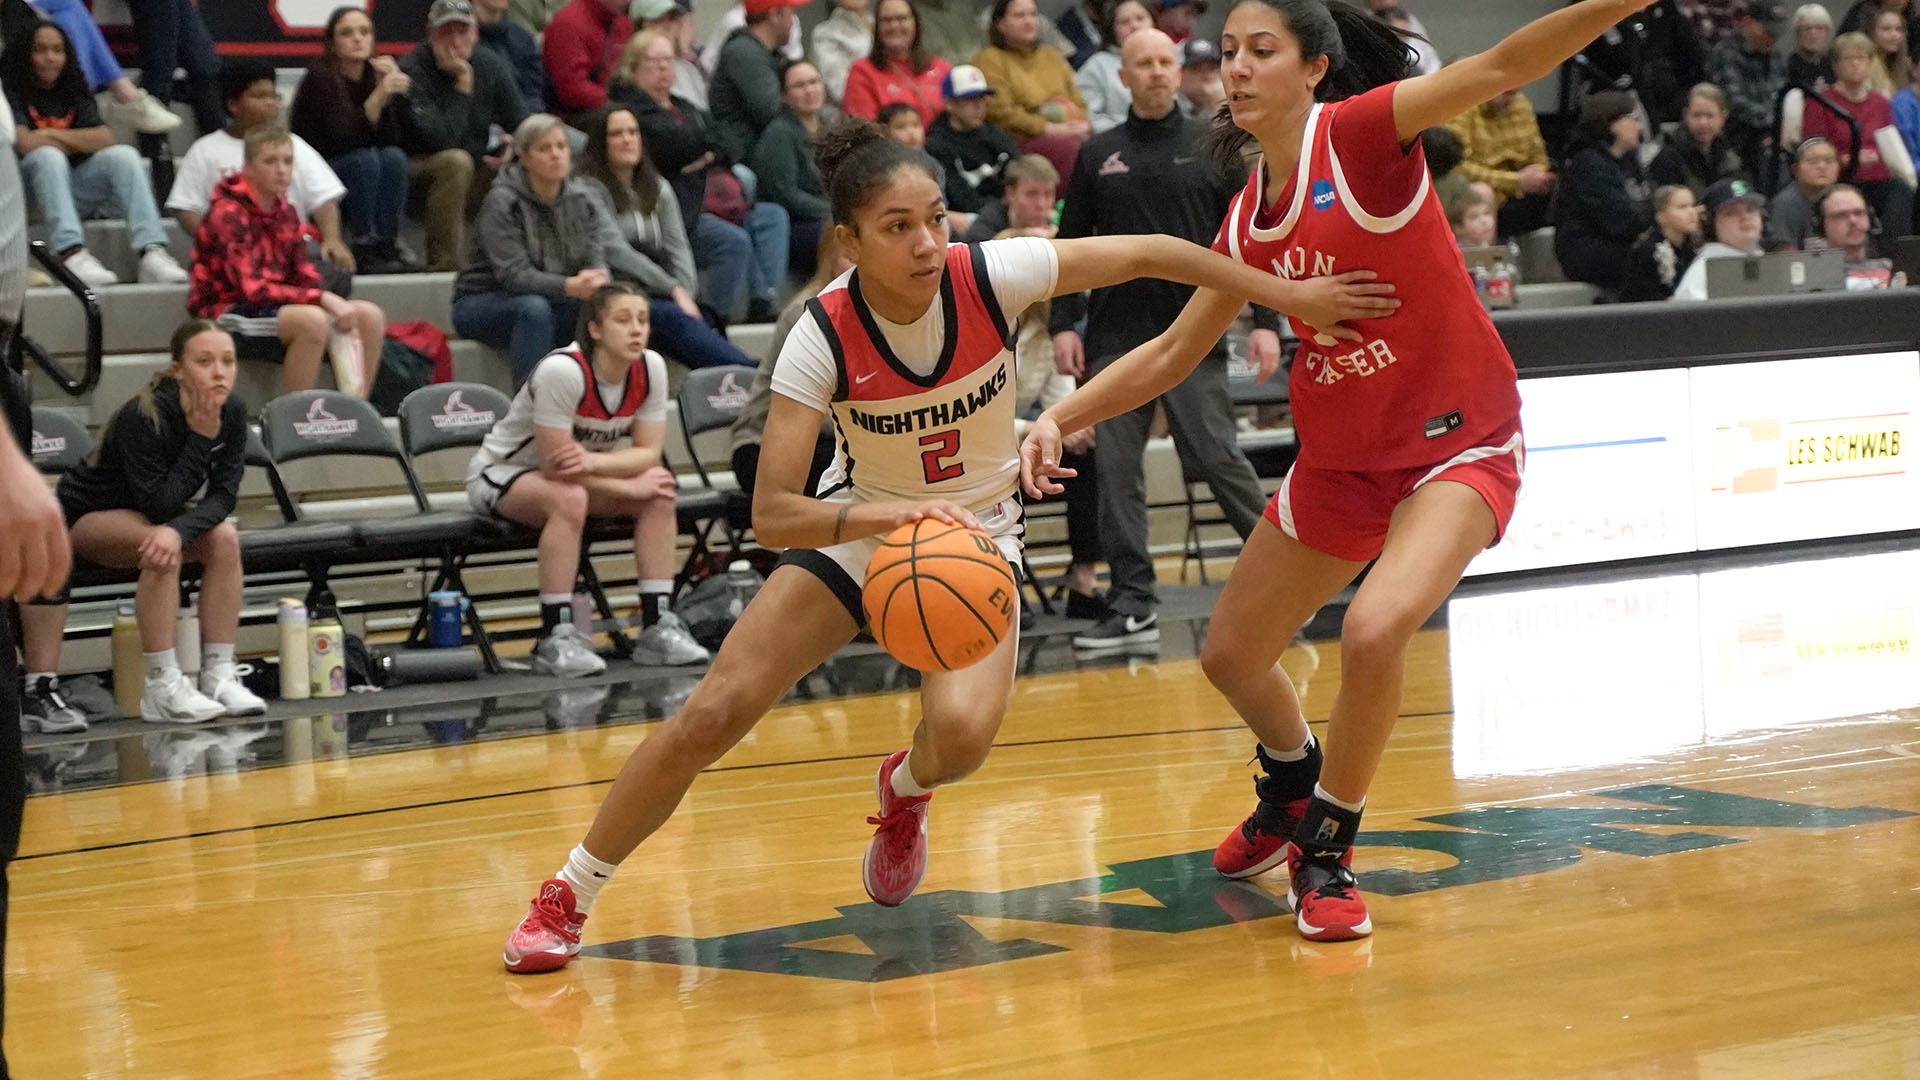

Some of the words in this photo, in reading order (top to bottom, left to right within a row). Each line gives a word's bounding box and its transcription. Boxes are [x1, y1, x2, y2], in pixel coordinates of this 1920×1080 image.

[850, 362, 1007, 435] NIGHTHAWKS
[918, 429, 965, 485] 2
[1788, 437, 1816, 465] LES
[1824, 431, 1901, 463] SCHWAB
